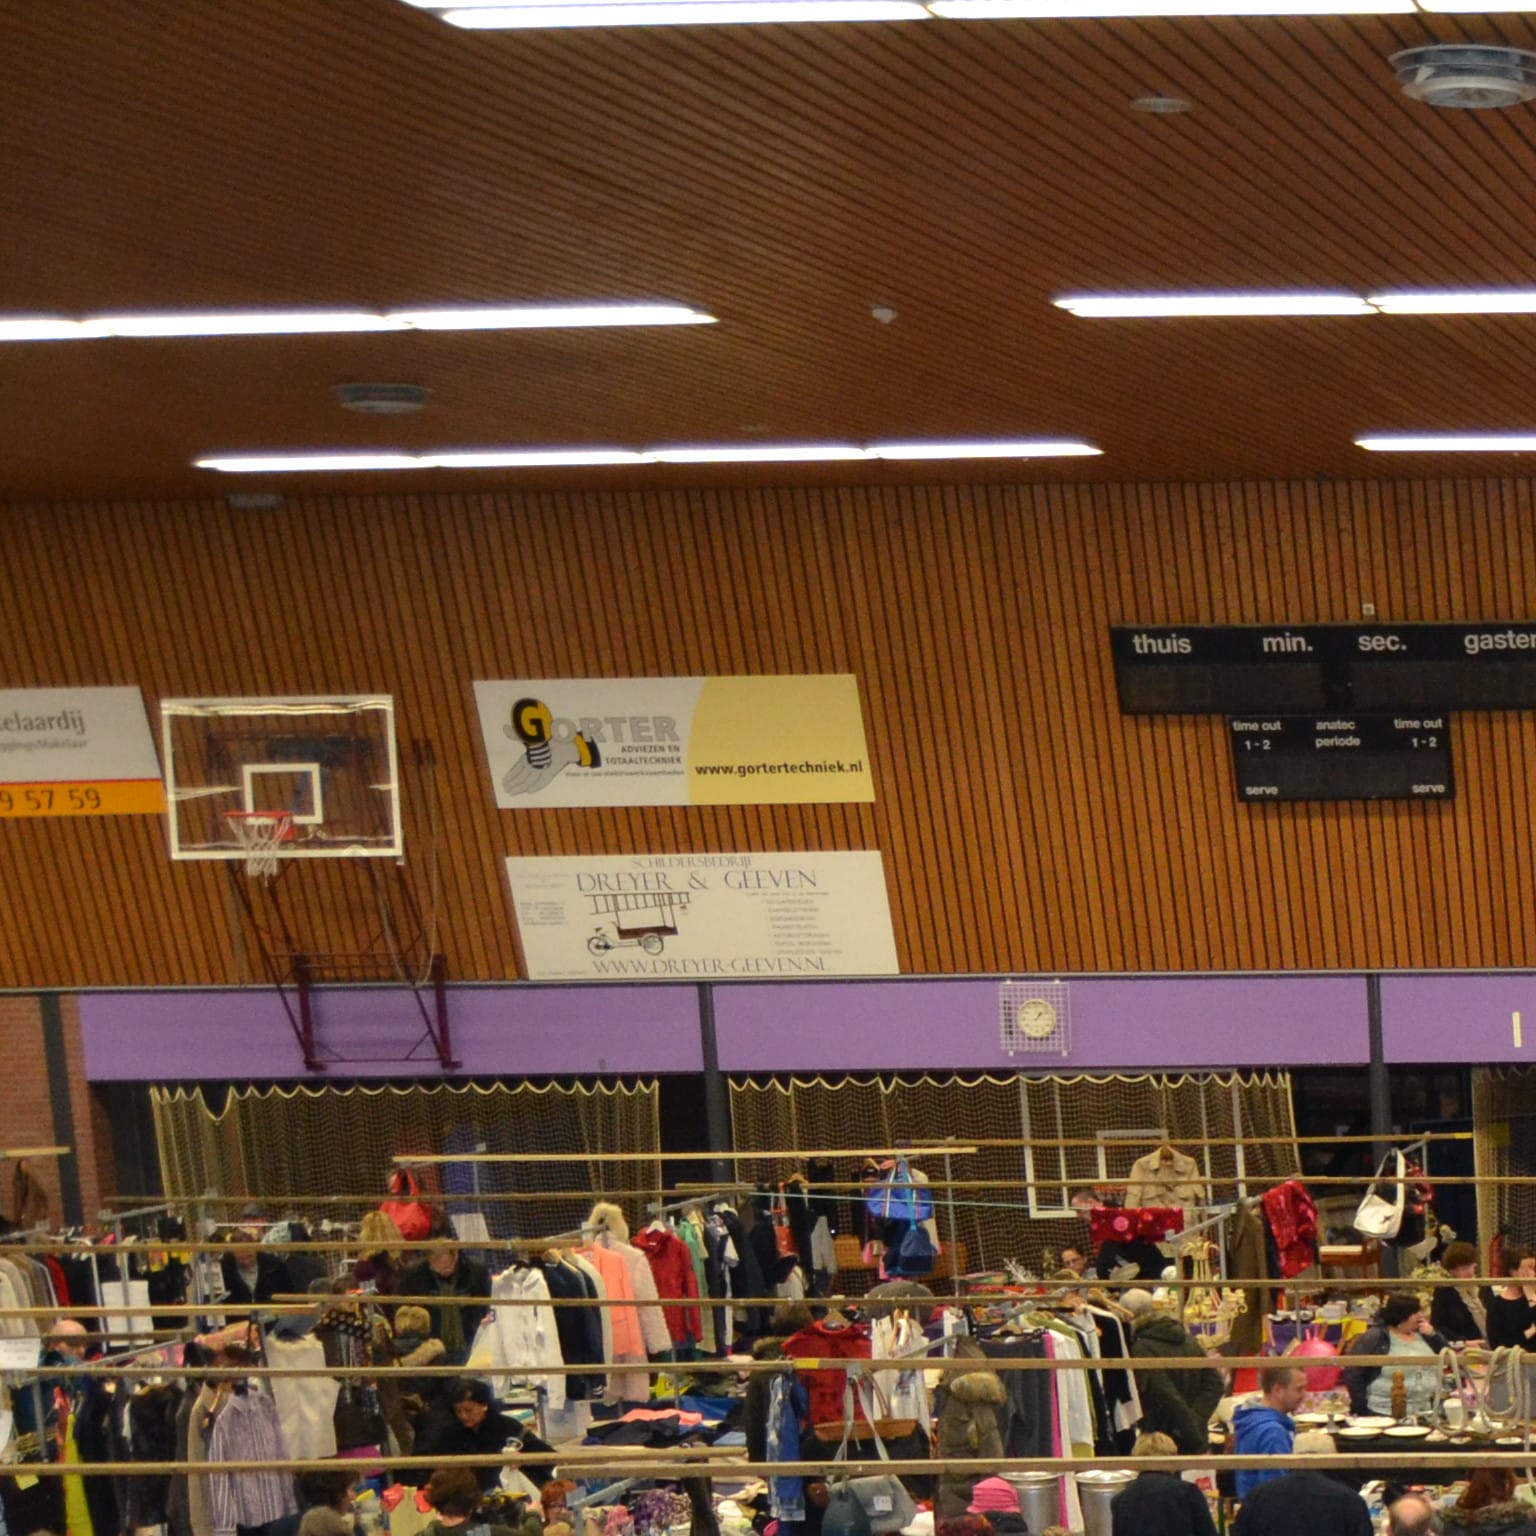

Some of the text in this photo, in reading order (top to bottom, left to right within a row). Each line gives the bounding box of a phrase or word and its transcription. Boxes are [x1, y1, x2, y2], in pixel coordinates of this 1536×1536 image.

[1132, 632, 1192, 654] thuis
[1262, 631, 1314, 653] min.
[1357, 634, 1408, 651] sec.
[503, 697, 681, 745] GORTER
[1232, 719, 1282, 732] time out
[1393, 717, 1444, 730] time out
[1315, 735, 1361, 749] periode
[695, 761, 864, 778] www.gortertechniek.nl
[1245, 785, 1279, 796] serve
[1412, 783, 1446, 794] serve
[24, 789, 55, 811] 57
[67, 787, 102, 809] 59
[575, 872, 673, 893] DREYER
[687, 871, 709, 891] &
[723, 869, 819, 890] GEEVEN
